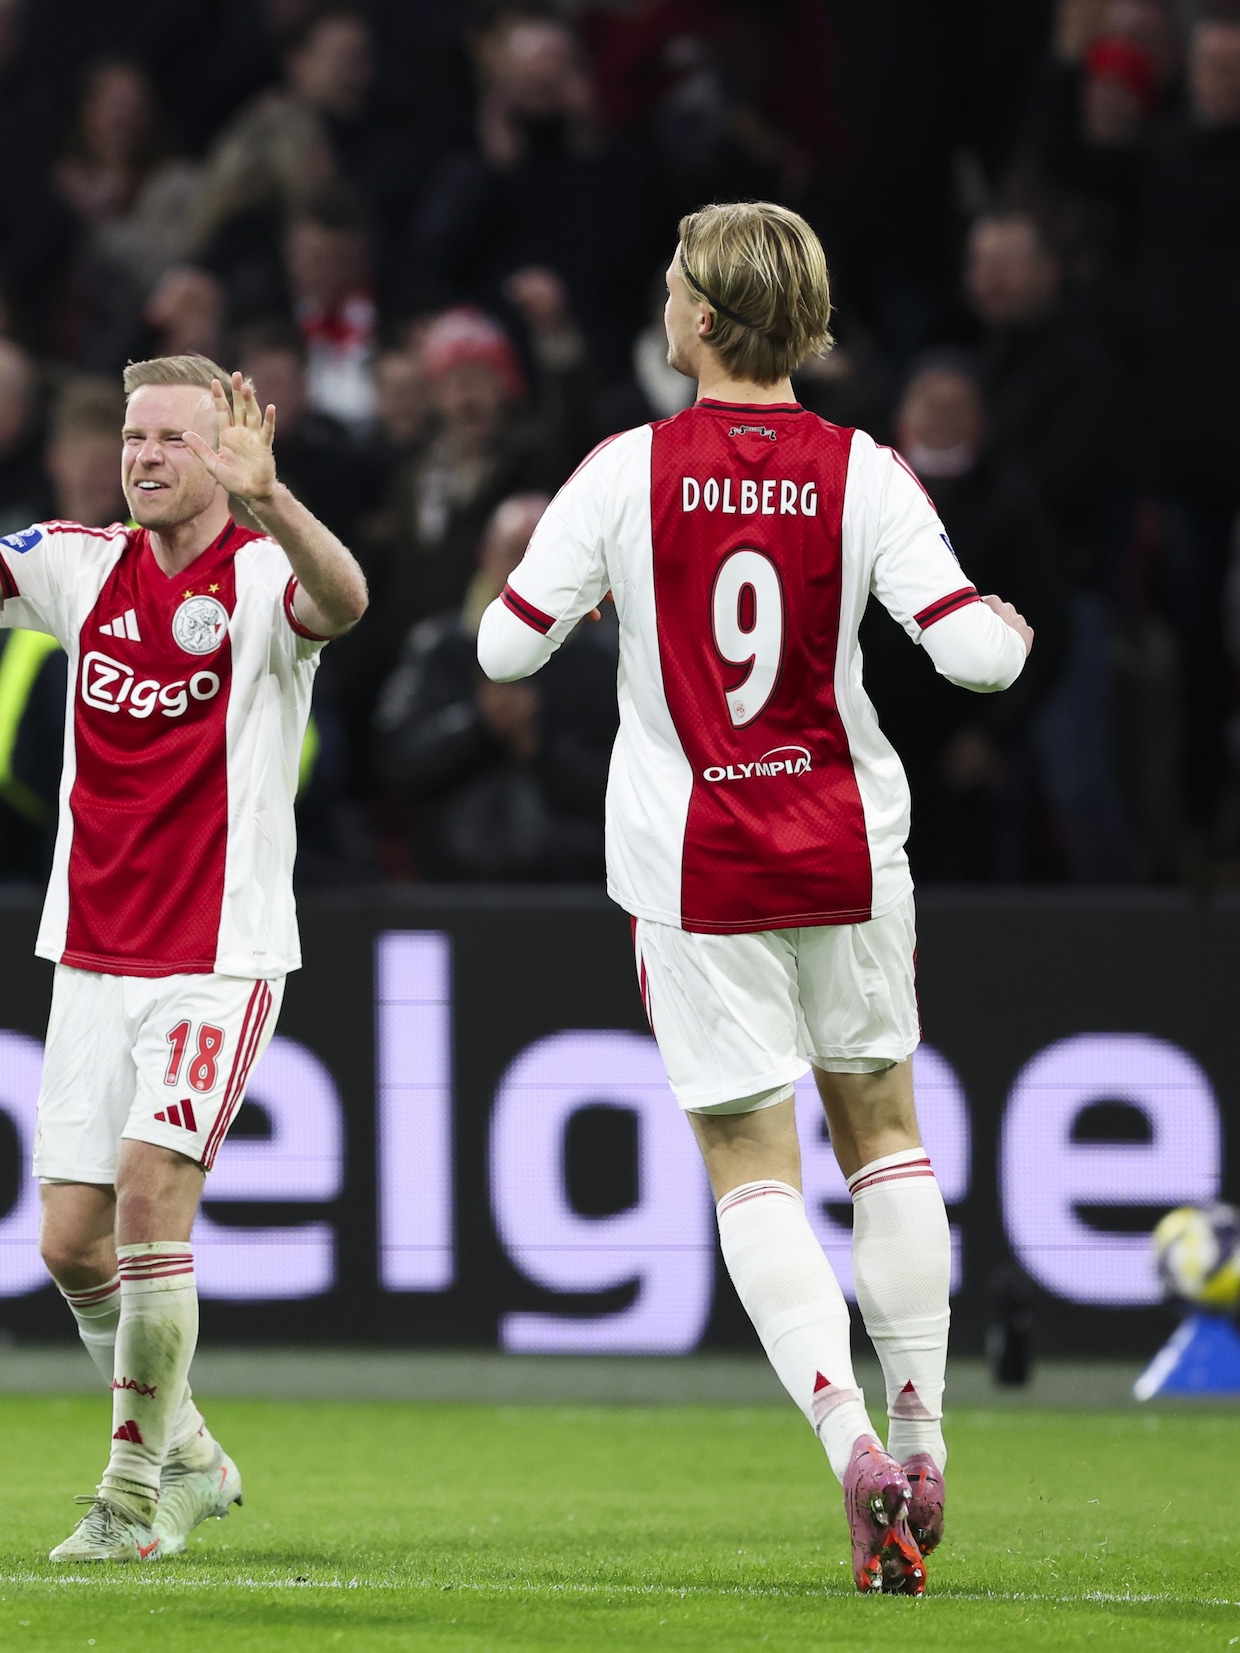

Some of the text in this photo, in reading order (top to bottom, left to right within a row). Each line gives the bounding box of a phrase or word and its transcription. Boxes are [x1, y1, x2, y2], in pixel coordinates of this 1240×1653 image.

[681, 476, 818, 517] DOLBERG
[712, 547, 785, 729] 9
[84, 658, 220, 719] Ziggo
[703, 757, 813, 784] OLYMPIA
[164, 1019, 225, 1094] 18
